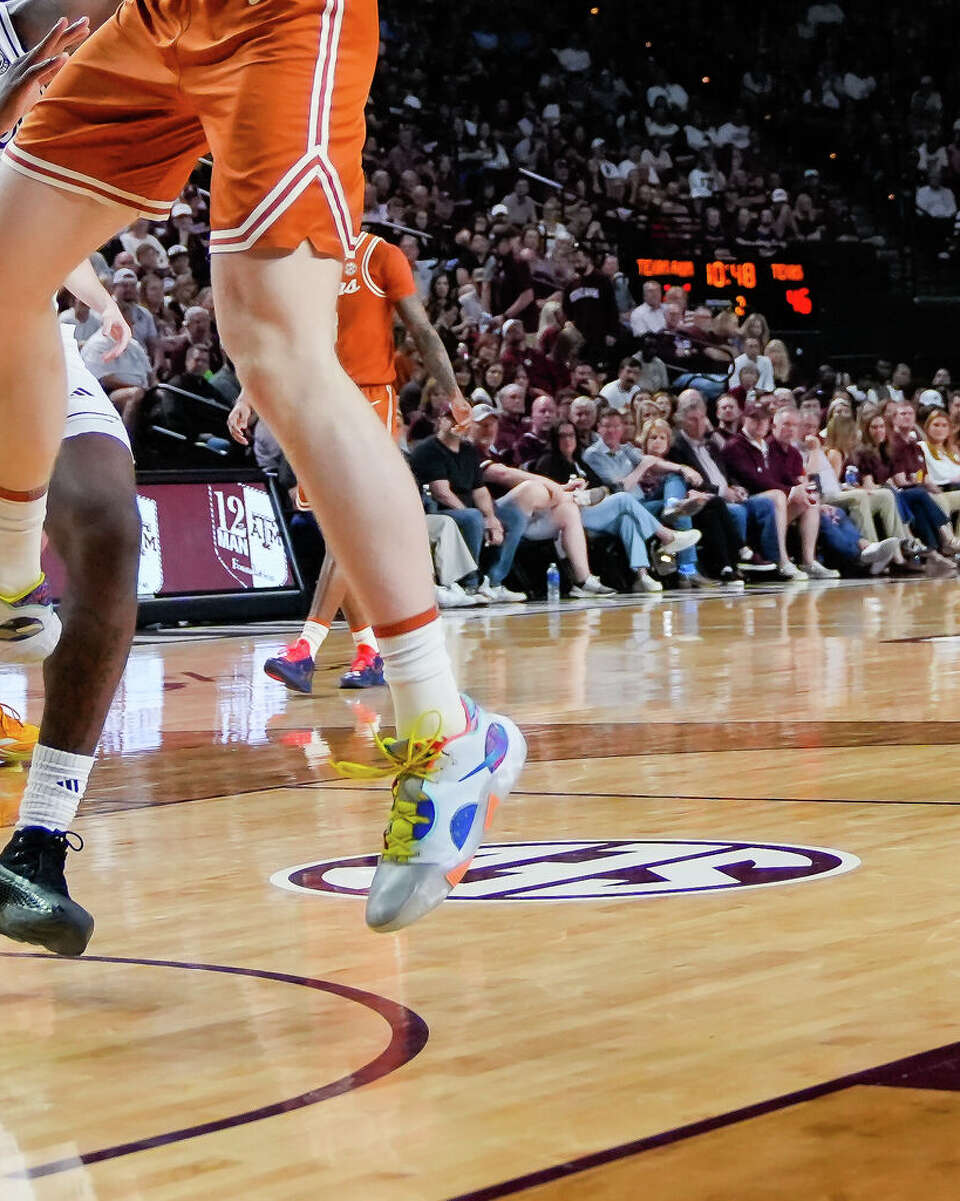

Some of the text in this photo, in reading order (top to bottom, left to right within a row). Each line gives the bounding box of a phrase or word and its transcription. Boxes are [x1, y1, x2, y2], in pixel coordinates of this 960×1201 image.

[706, 260, 757, 289] 10:48
[214, 491, 247, 538] 12
[217, 527, 249, 558] MAN
